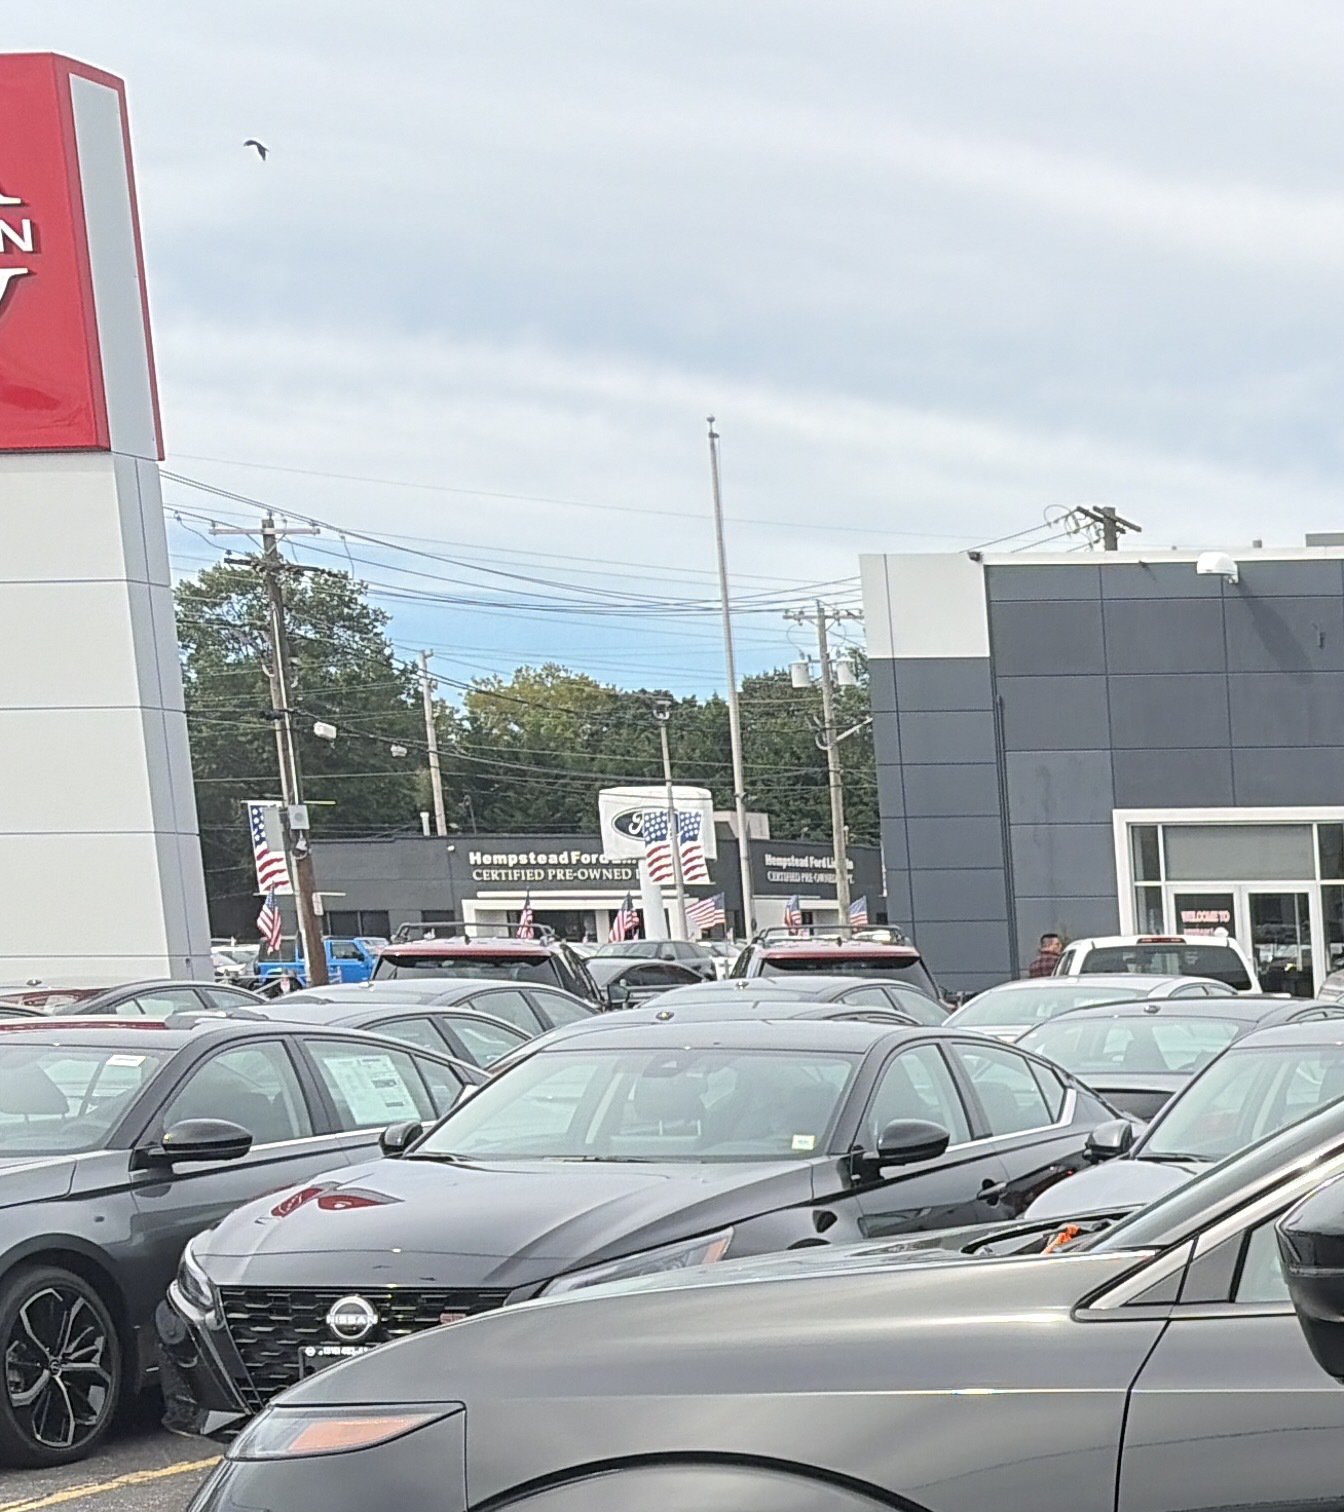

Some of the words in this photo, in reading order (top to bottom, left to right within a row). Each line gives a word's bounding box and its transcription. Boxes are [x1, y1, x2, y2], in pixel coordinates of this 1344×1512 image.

[469, 851, 569, 867] Hempstead
[473, 868, 545, 881] CERTIFIED
[548, 868, 632, 881] PRE-OWNED
[1181, 910, 1219, 923] WELCOME
[1219, 910, 1230, 923] TO
[327, 1313, 378, 1325] NISSAN
